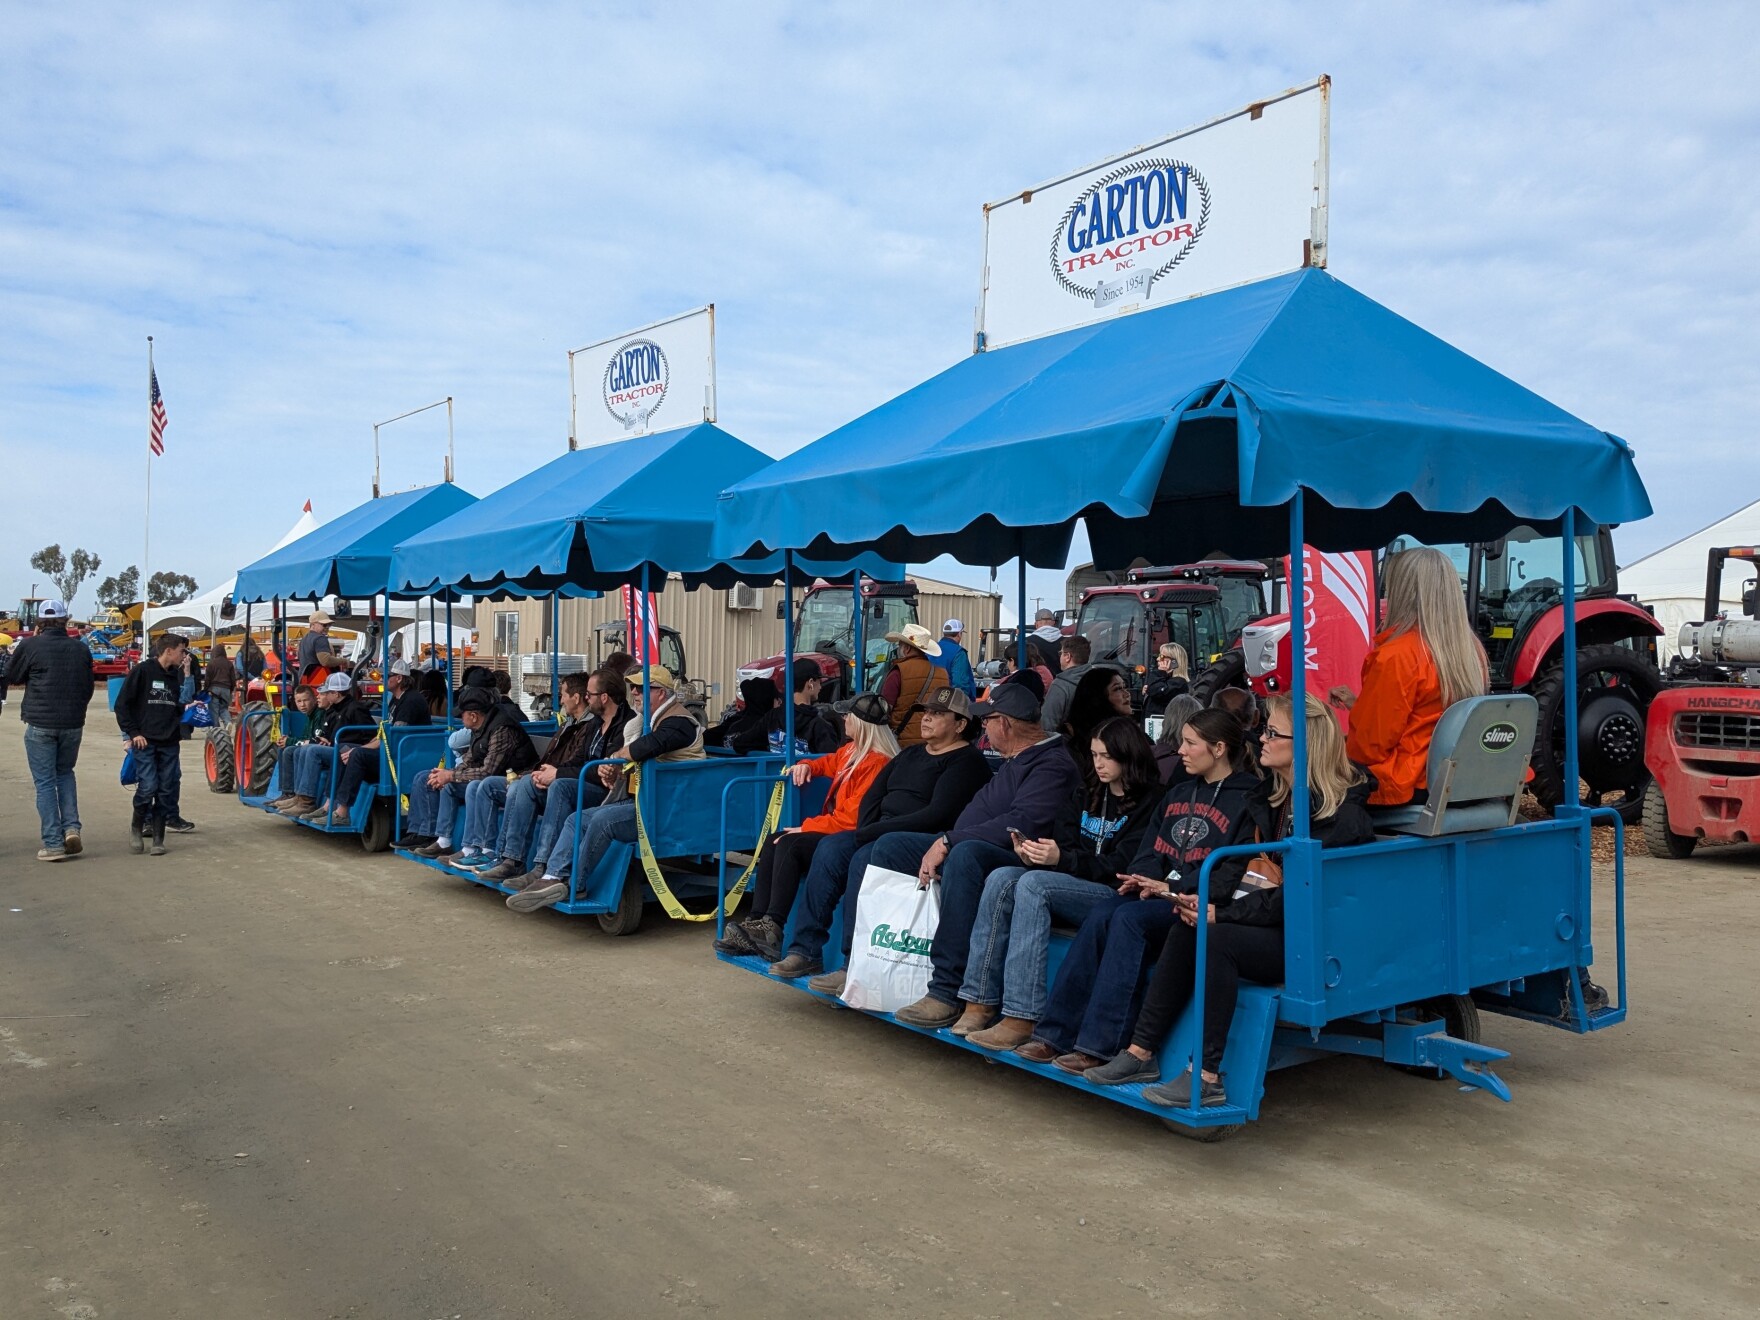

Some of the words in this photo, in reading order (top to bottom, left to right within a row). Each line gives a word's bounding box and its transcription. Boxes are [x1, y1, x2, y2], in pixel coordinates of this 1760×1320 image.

[1067, 166, 1190, 253] GARTON
[1062, 223, 1195, 273] TRACTOR
[1102, 287, 1124, 301] Since
[1125, 274, 1144, 292] 1954
[609, 344, 661, 392] GARTON
[608, 383, 664, 405] TRACTOR
[1483, 727, 1515, 743] slime
